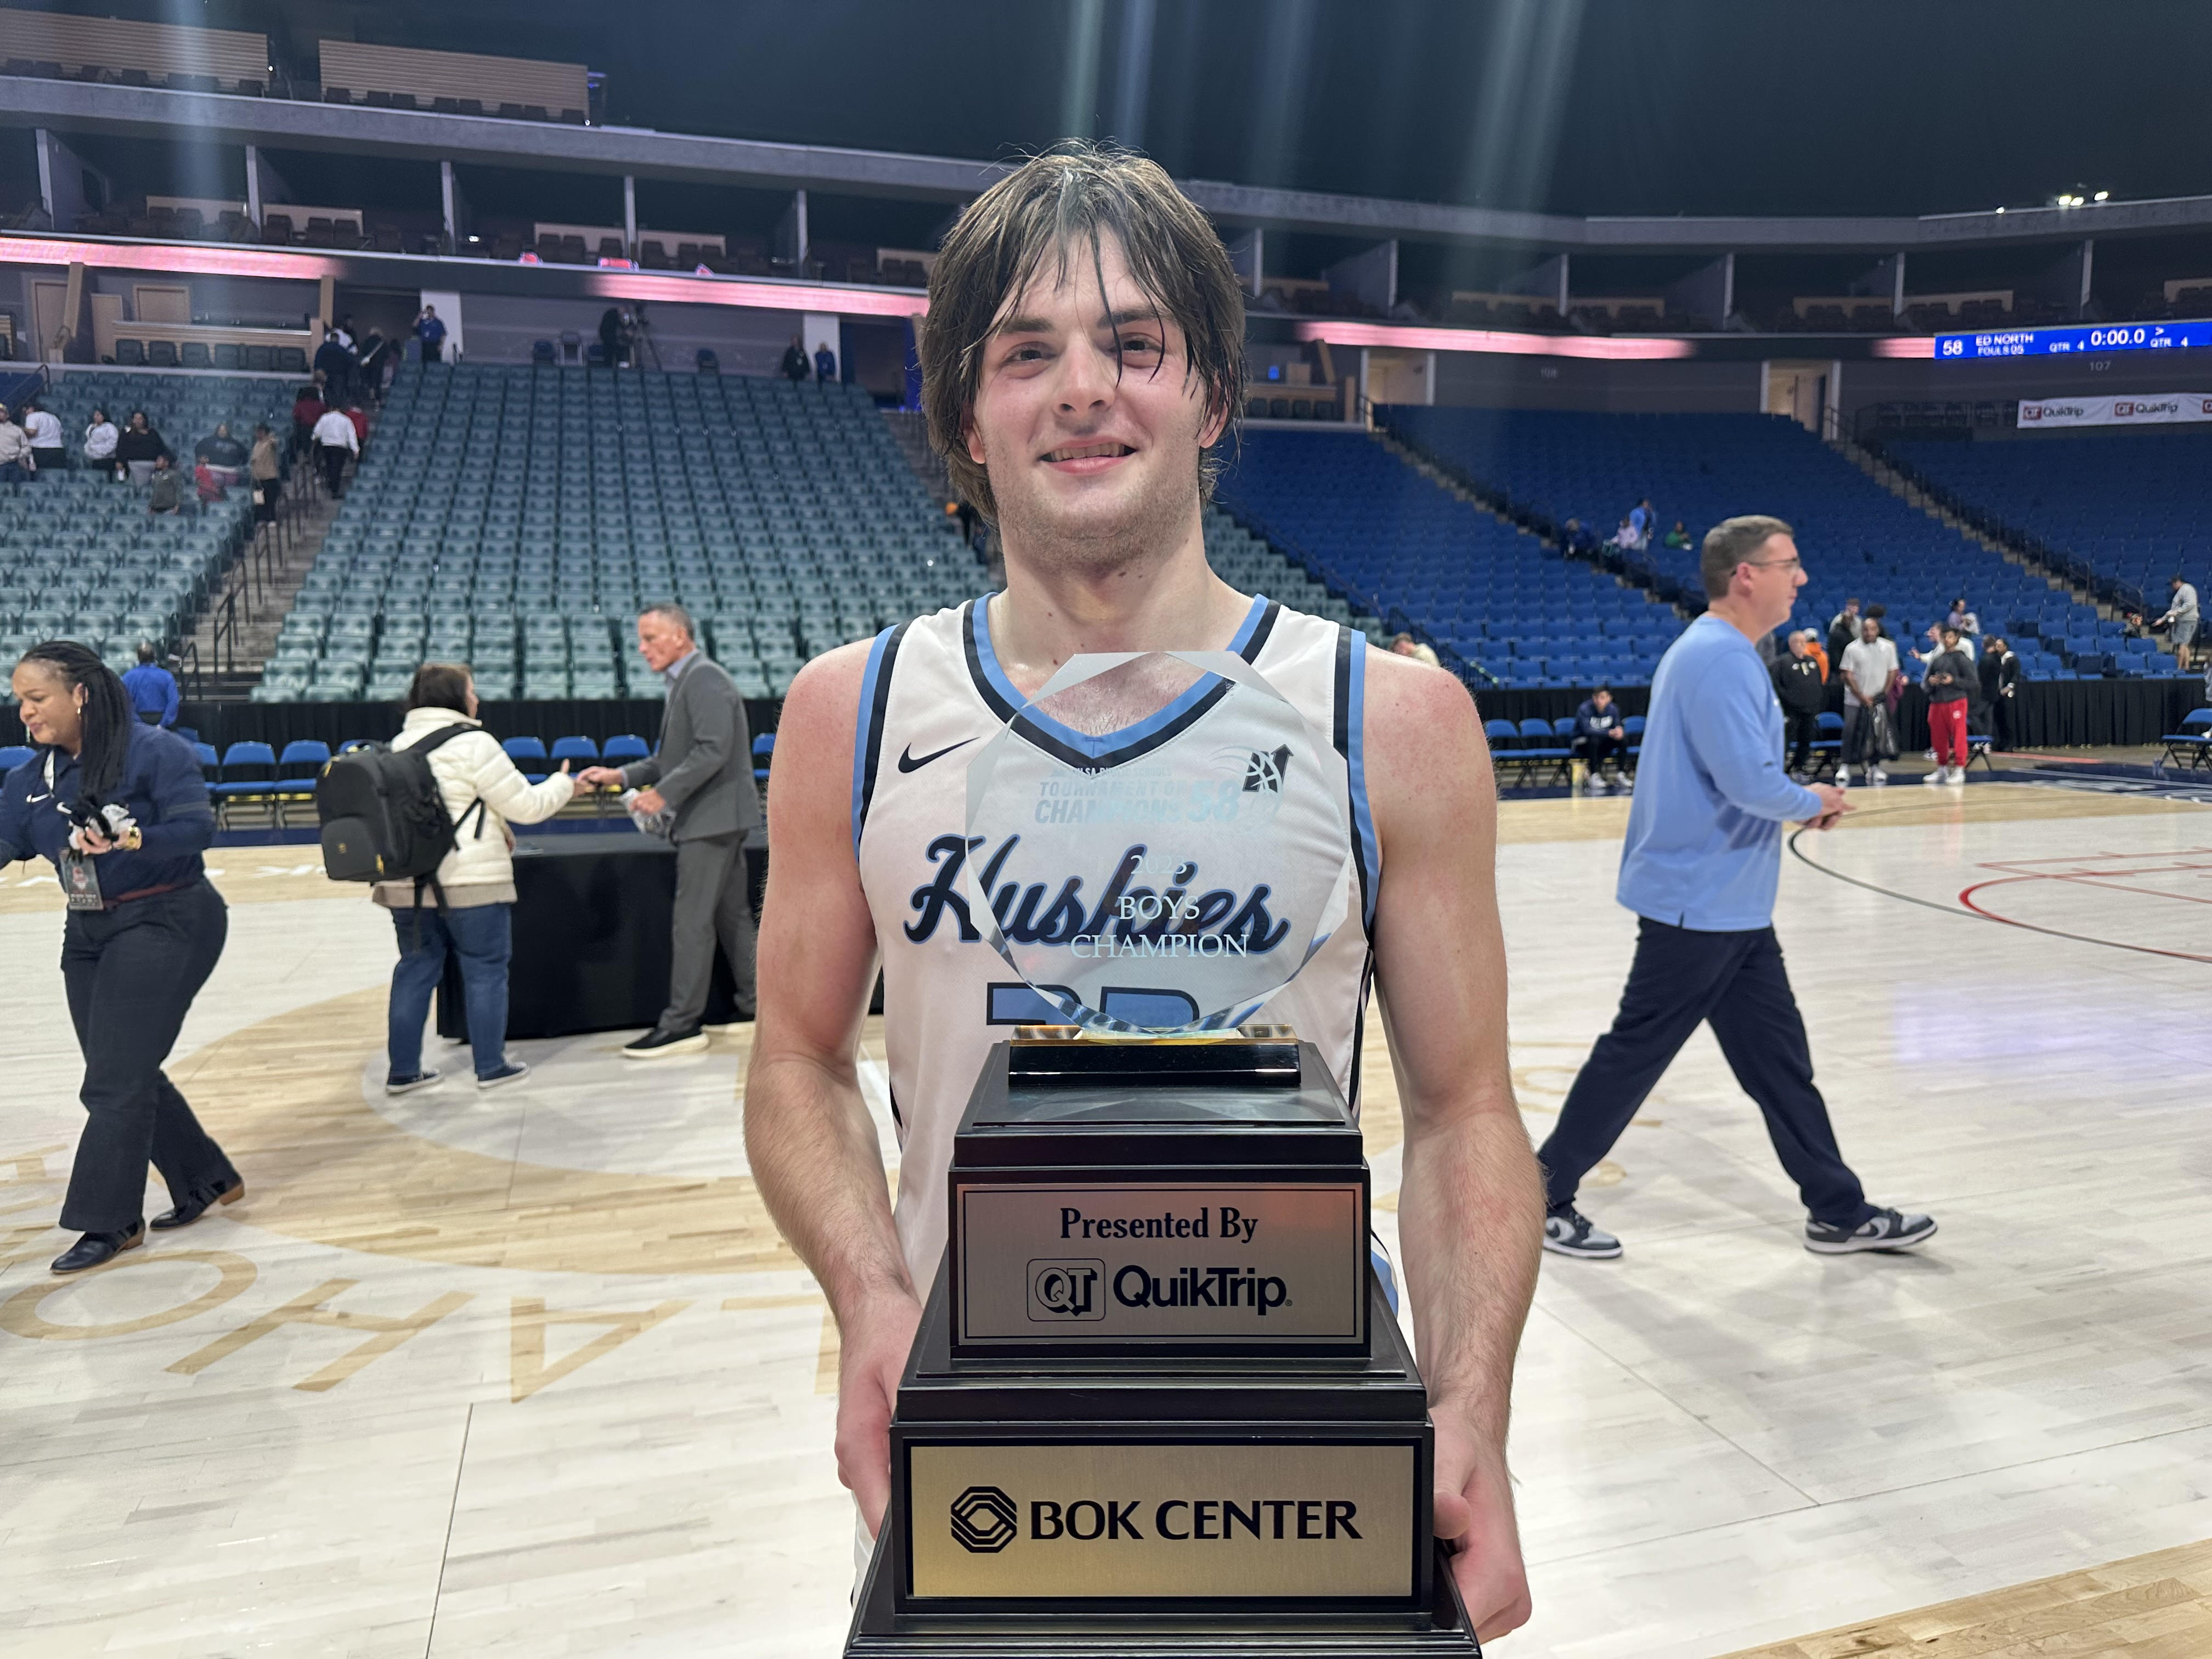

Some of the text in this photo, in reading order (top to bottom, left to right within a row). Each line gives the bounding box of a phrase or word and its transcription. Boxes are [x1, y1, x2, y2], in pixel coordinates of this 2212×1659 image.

[1943, 339, 1963, 356] 58
[1976, 332, 2034, 347] ED NORTH
[2049, 339, 2085, 353] QTR 4
[2091, 328, 2145, 347] 0:00.0
[2150, 336, 2188, 348] QTR 4
[2089, 360, 2111, 371] 107
[1186, 780, 1241, 823] 58
[1130, 854, 1187, 875] 2023
[903, 833, 1291, 955] Huskies
[1118, 895, 1200, 921] BOYS
[1070, 934, 1249, 958] CHAMPION
[1060, 1206, 1259, 1244] Presented By
[1035, 1267, 1098, 1317] QT
[1029, 1499, 1363, 1540] BOK CENTER
